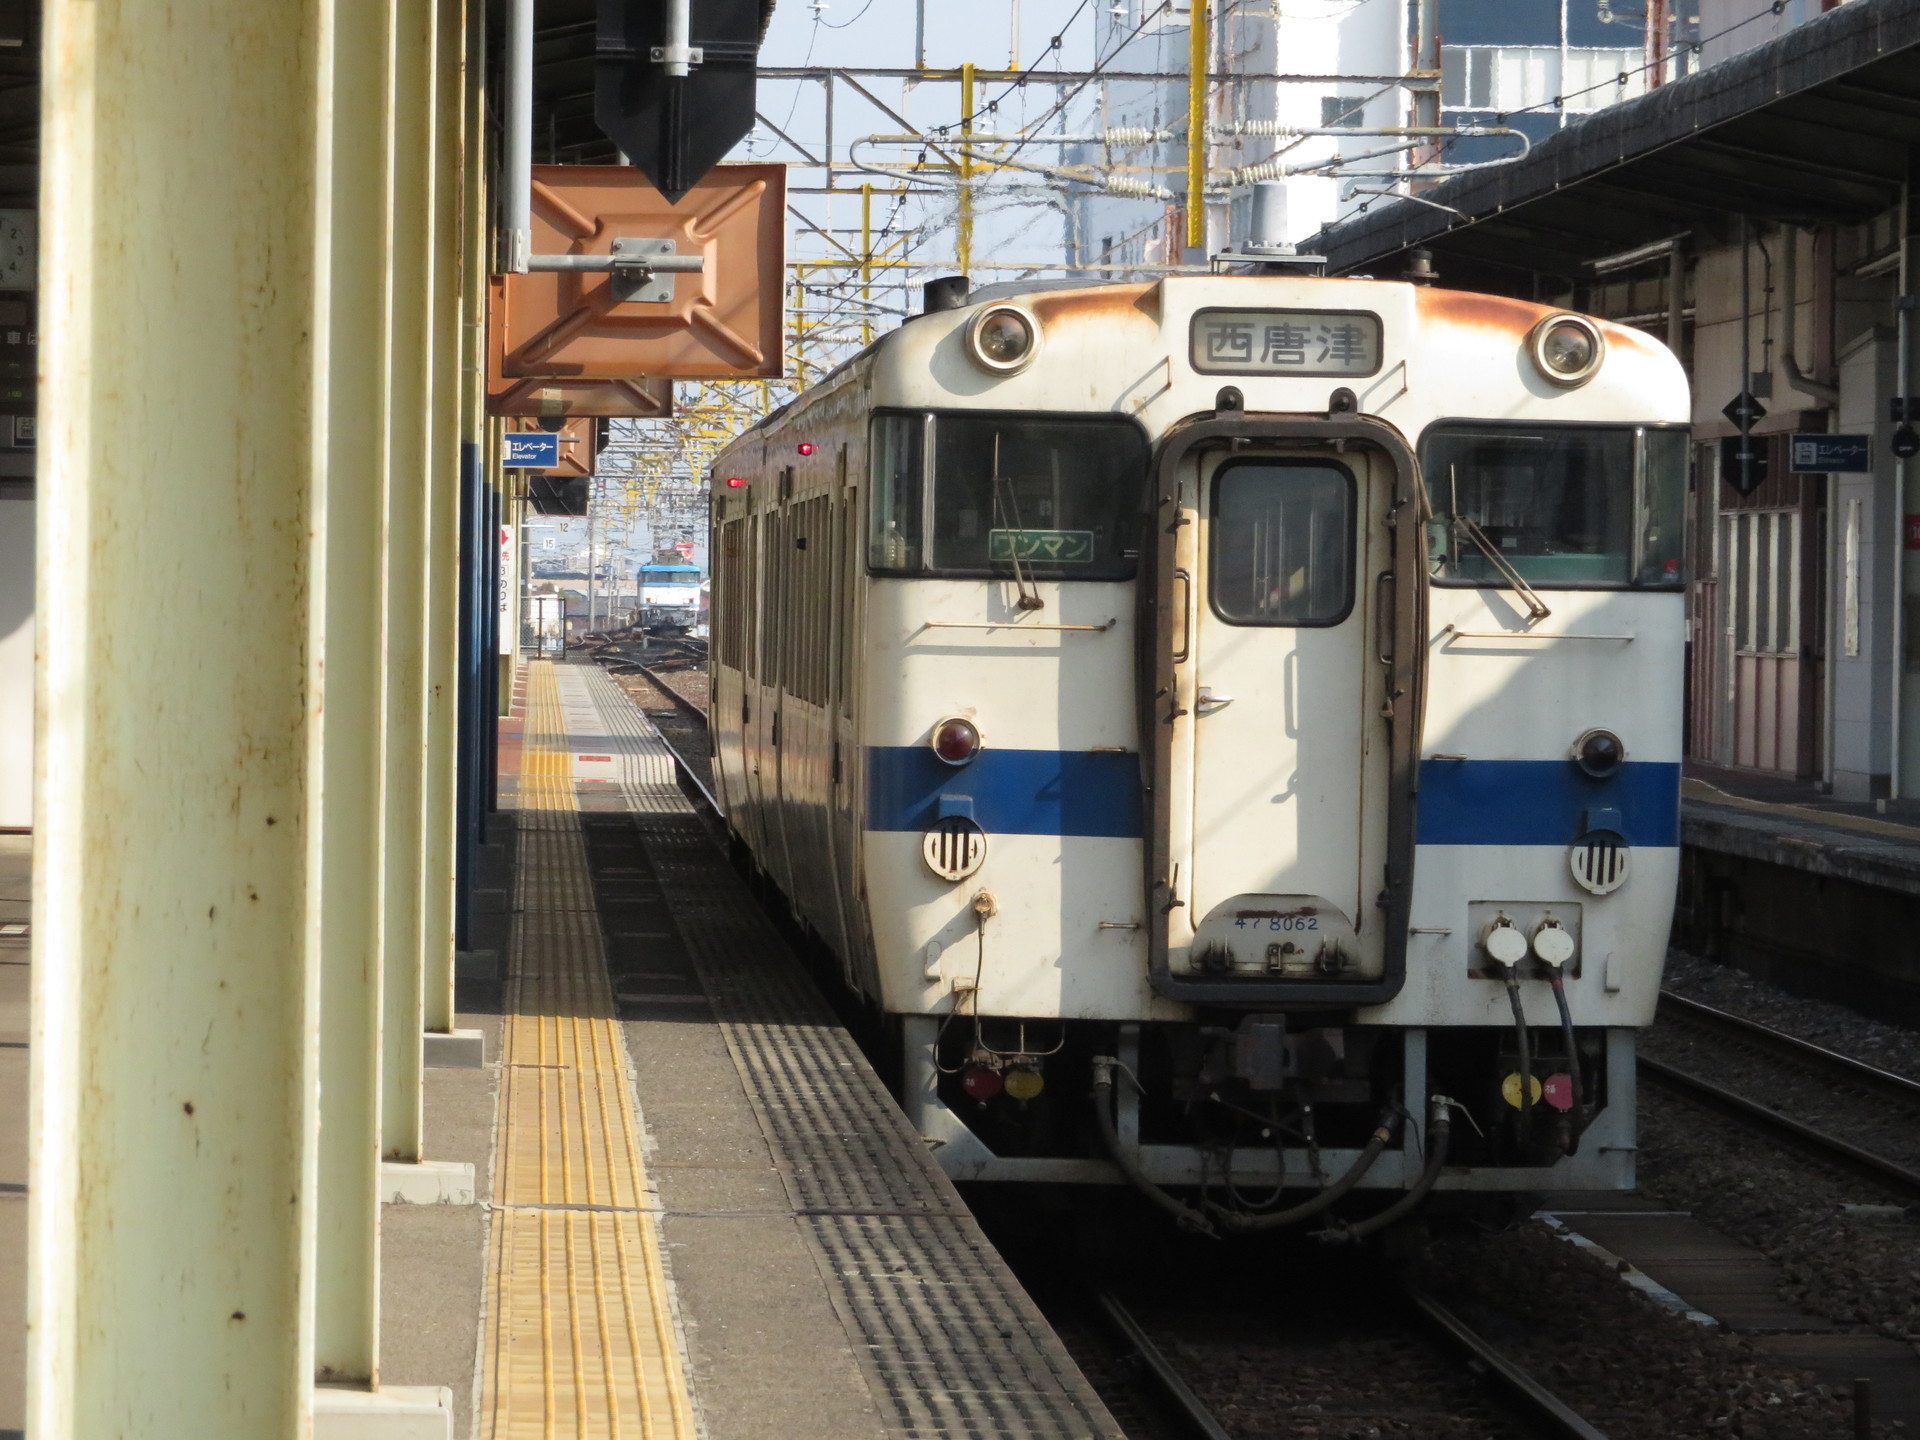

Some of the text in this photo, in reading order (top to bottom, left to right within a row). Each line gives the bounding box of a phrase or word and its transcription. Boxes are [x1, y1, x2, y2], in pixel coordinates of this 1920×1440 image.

[1205, 322, 1367, 366] 西唐津
[512, 442, 554, 452] エレベーター
[512, 452, 537, 460] Elevator
[560, 523, 569, 532] 12
[545, 540, 554, 549] 15
[994, 535, 1088, 558] ワンマン
[1269, 917, 1319, 931] 8062
